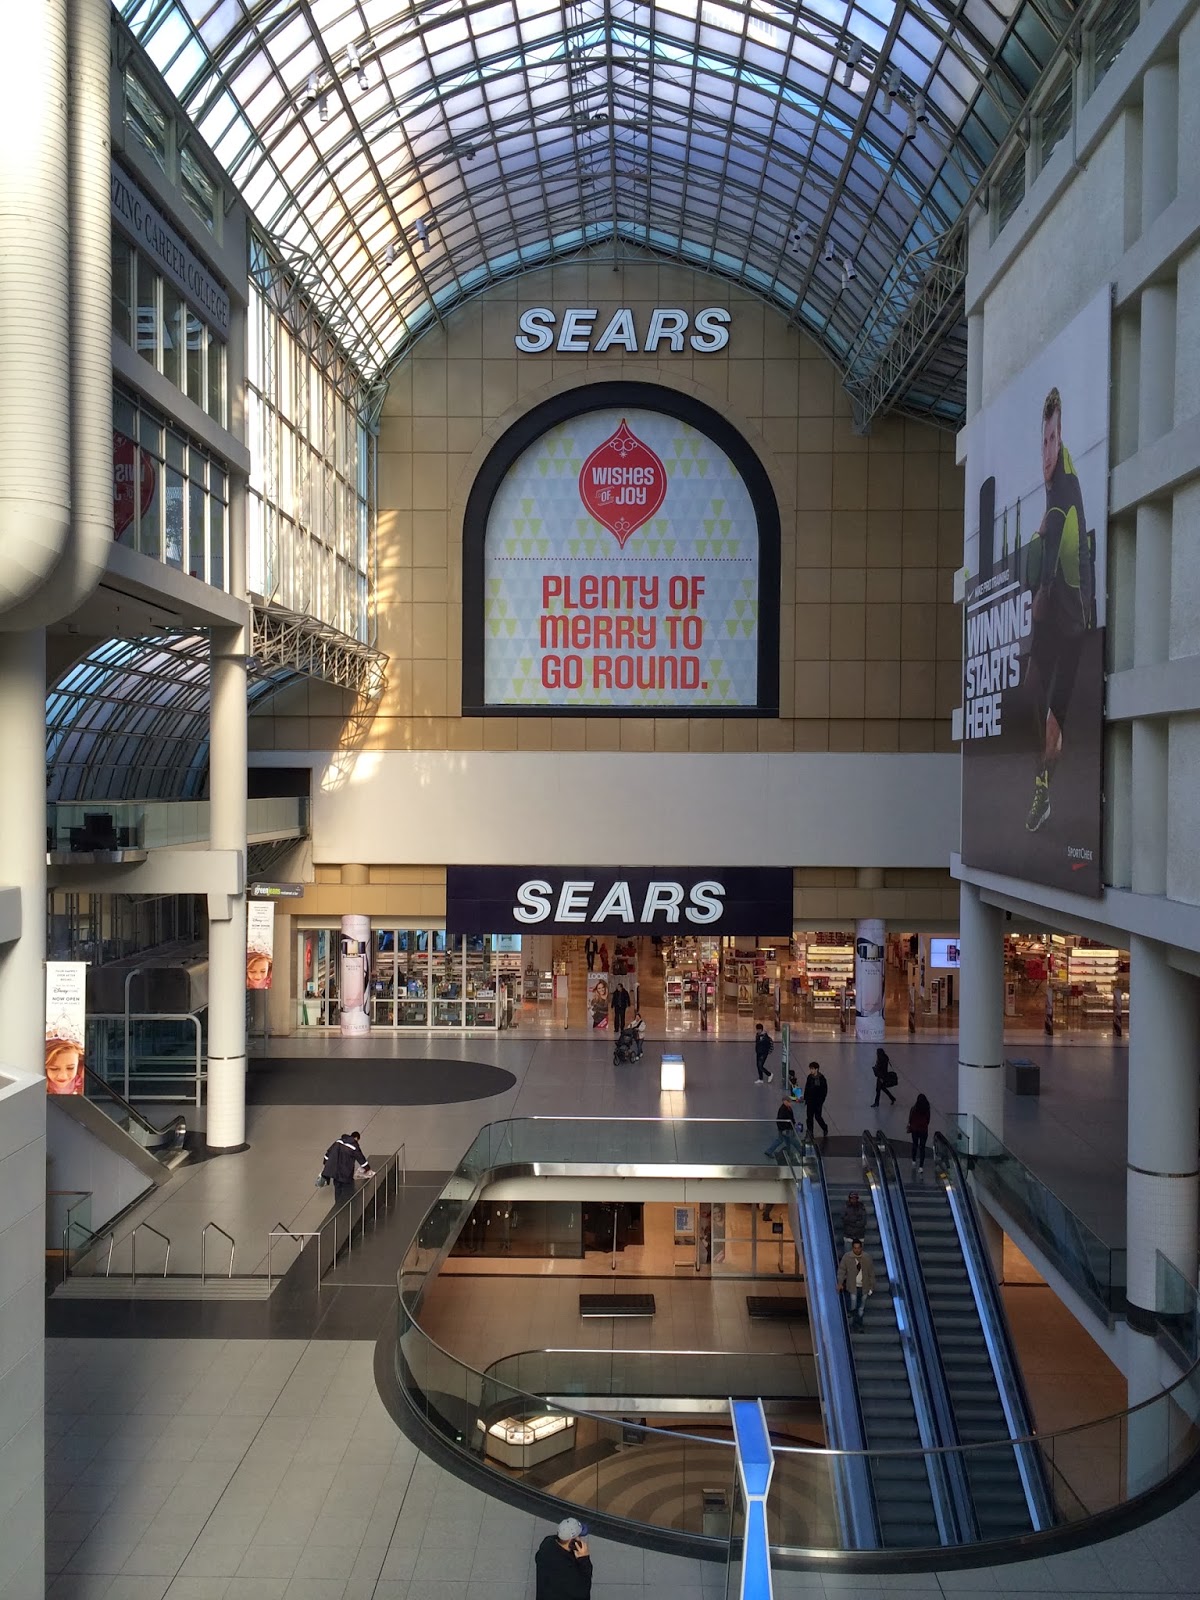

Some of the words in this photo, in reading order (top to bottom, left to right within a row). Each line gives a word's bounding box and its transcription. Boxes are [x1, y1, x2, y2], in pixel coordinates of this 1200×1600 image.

[111, 174, 143, 231] ZING
[145, 214, 186, 282] CAREER
[188, 263, 228, 327] COLLEGE
[514, 307, 732, 353] SEARS
[601, 490, 611, 502] OF
[669, 576, 706, 609] OF
[666, 615, 703, 650] TO
[967, 589, 1033, 657] WINNING
[541, 655, 583, 689] GO
[966, 642, 1021, 698] STARTS
[966, 693, 1002, 739] HERE
[512, 879, 726, 924] SEARS
